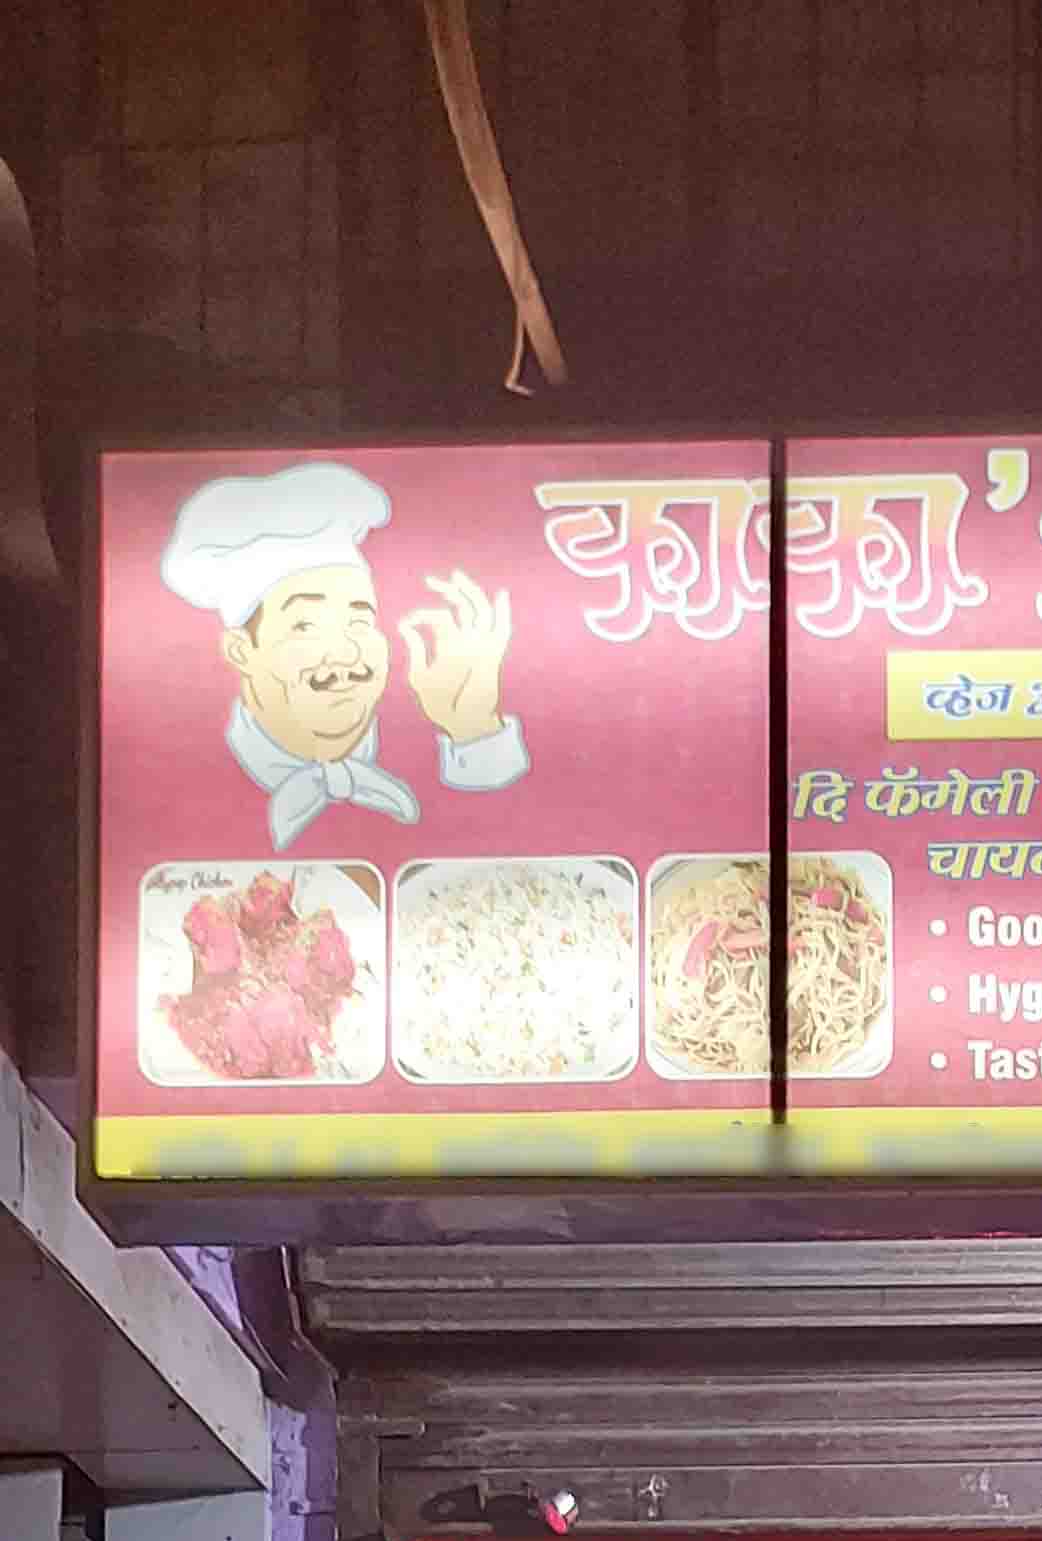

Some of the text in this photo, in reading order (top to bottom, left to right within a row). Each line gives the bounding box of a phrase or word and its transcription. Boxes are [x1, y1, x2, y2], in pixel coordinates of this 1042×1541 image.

[922, 672, 1014, 718] व्हेज
[791, 768, 855, 824] दि
[863, 765, 1041, 818] फॅमेली
